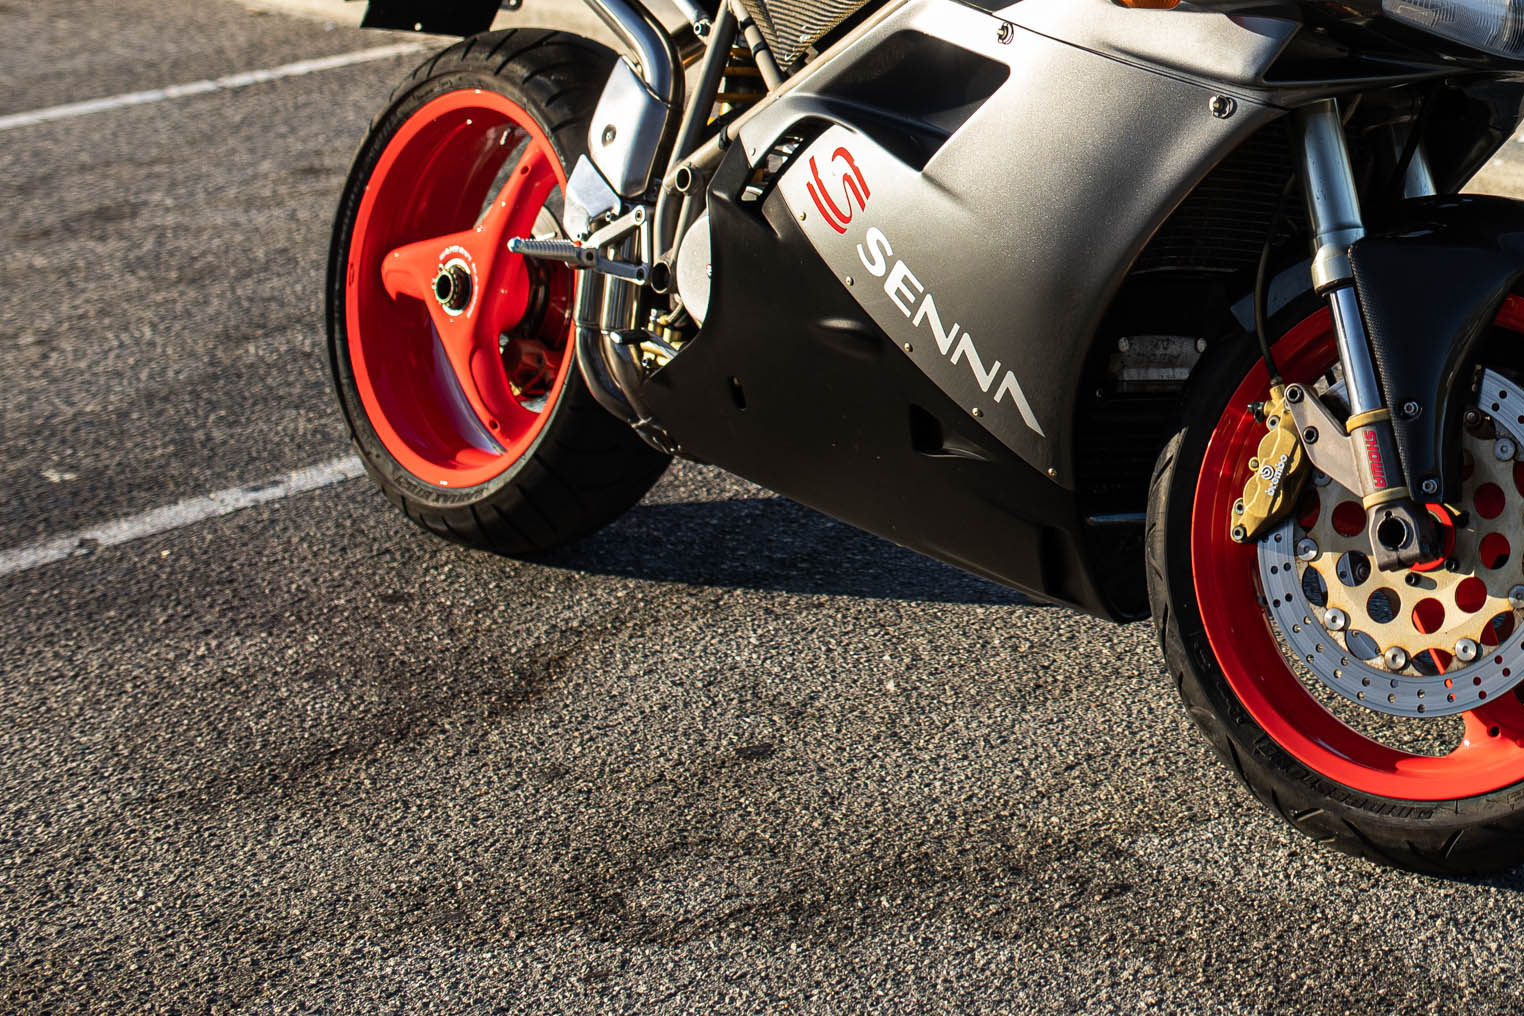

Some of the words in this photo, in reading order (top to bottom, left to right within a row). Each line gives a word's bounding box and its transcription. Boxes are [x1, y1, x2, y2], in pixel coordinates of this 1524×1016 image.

[857, 226, 1046, 438] SENNA
[1264, 453, 1288, 497] brembo
[1362, 430, 1387, 488] SHOWA
